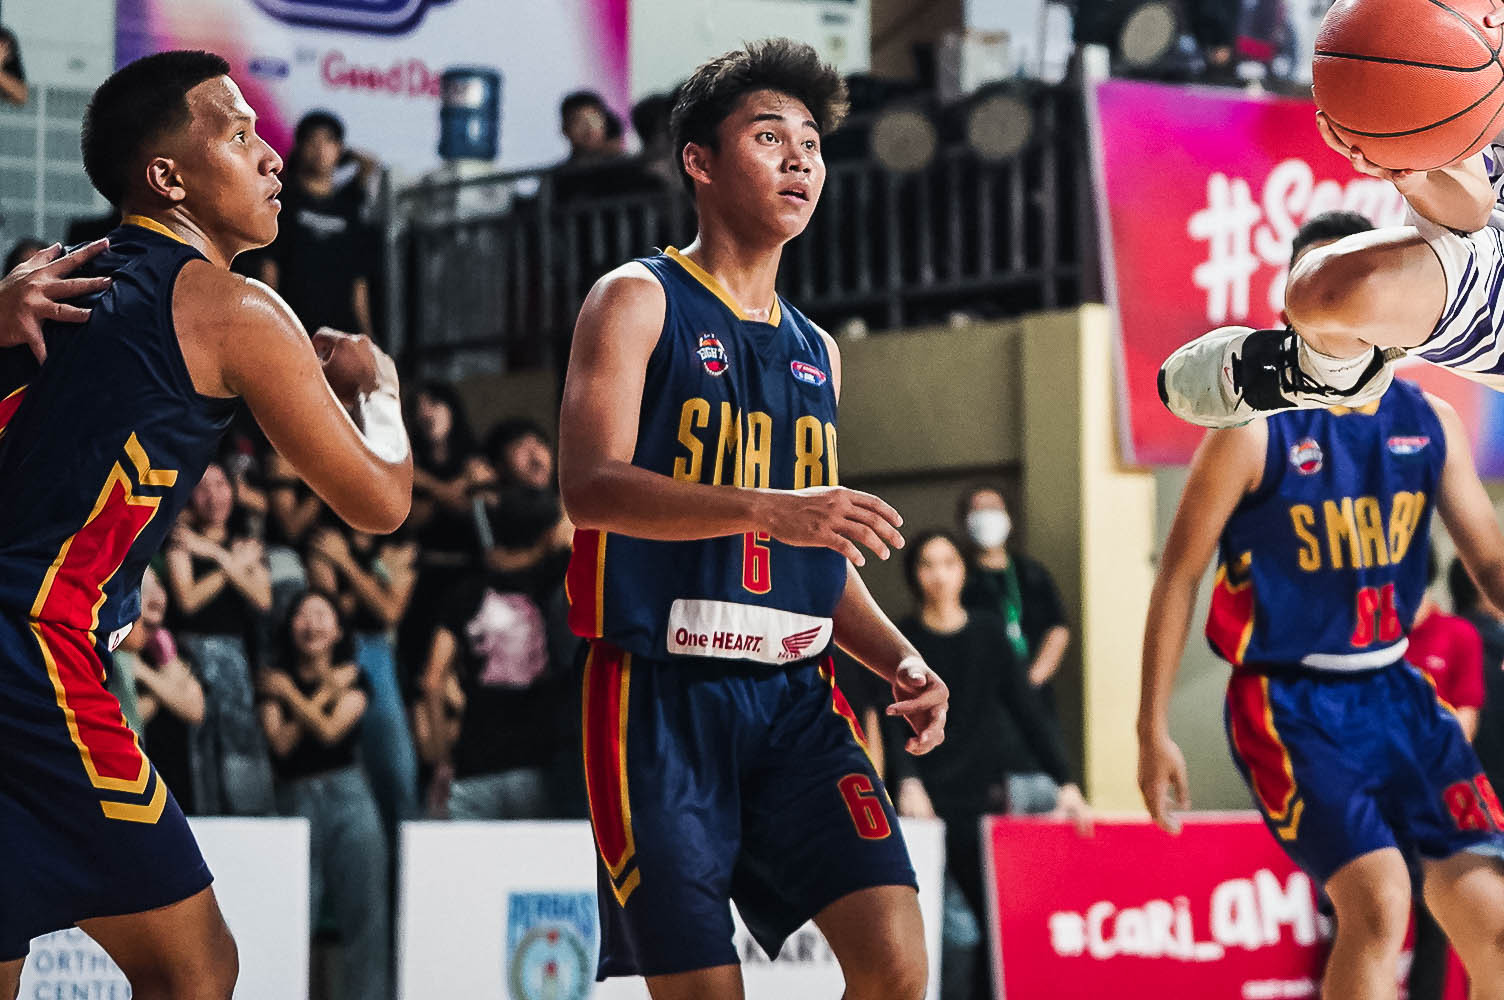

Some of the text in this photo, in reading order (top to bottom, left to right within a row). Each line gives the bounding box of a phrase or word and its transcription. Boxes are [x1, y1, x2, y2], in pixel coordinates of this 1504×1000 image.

[673, 397, 772, 488] SMA
[742, 531, 772, 594] 6
[1290, 496, 1389, 571] SMA
[675, 627, 764, 652] One HEART.
[837, 773, 891, 840] 6
